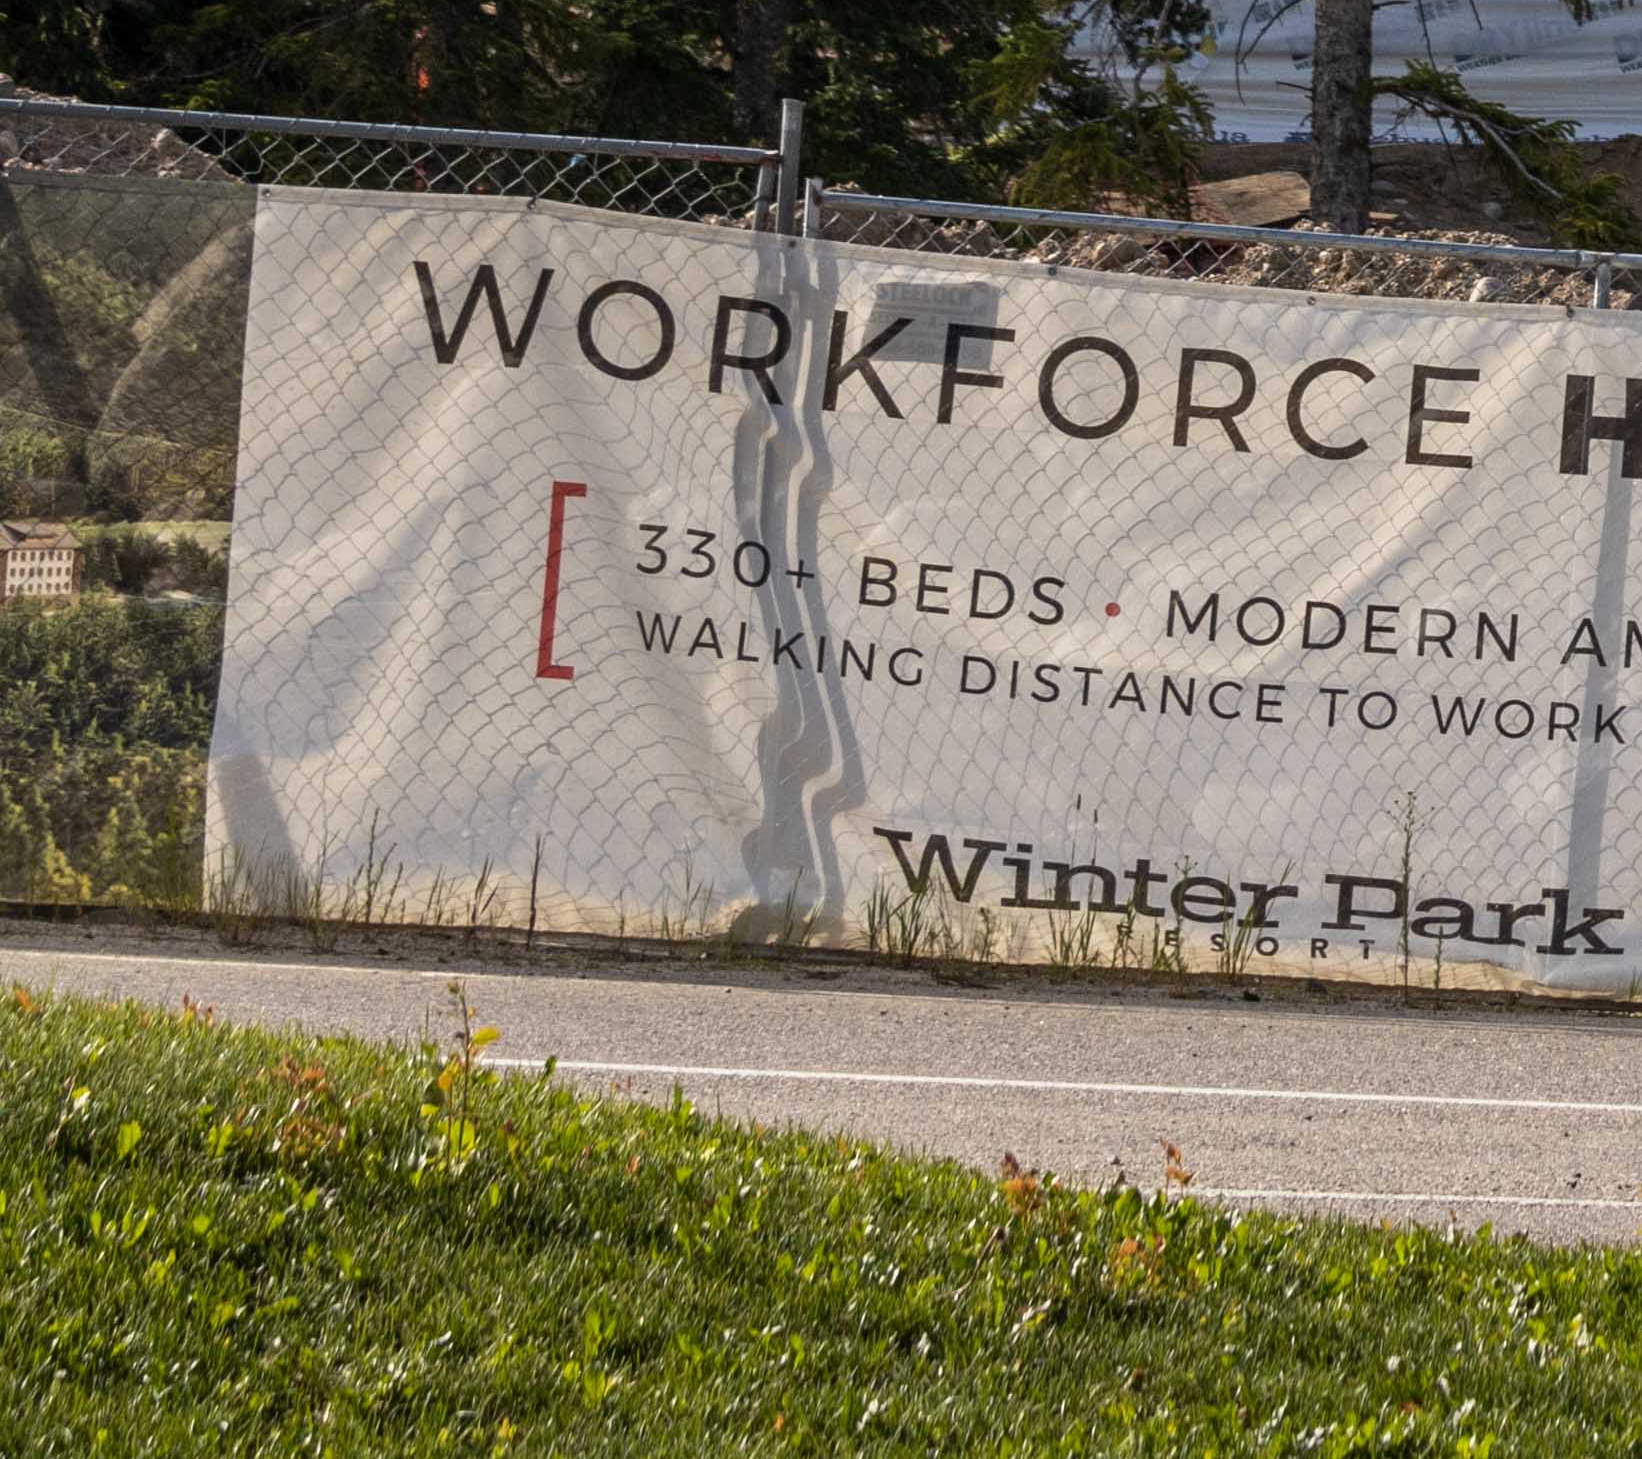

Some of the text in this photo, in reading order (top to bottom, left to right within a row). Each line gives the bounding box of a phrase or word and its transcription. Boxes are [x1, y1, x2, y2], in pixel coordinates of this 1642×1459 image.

[413, 260, 1479, 468] WORKFORCE
[637, 523, 816, 589] 330+
[859, 555, 1065, 626] BEDS
[1166, 590, 1519, 663] MODERN
[636, 609, 923, 688] WALKING
[961, 656, 1286, 725] DISTANCE
[1320, 685, 1397, 731] TO
[1431, 693, 1627, 746] WORK
[873, 827, 1625, 958] Winter Park
